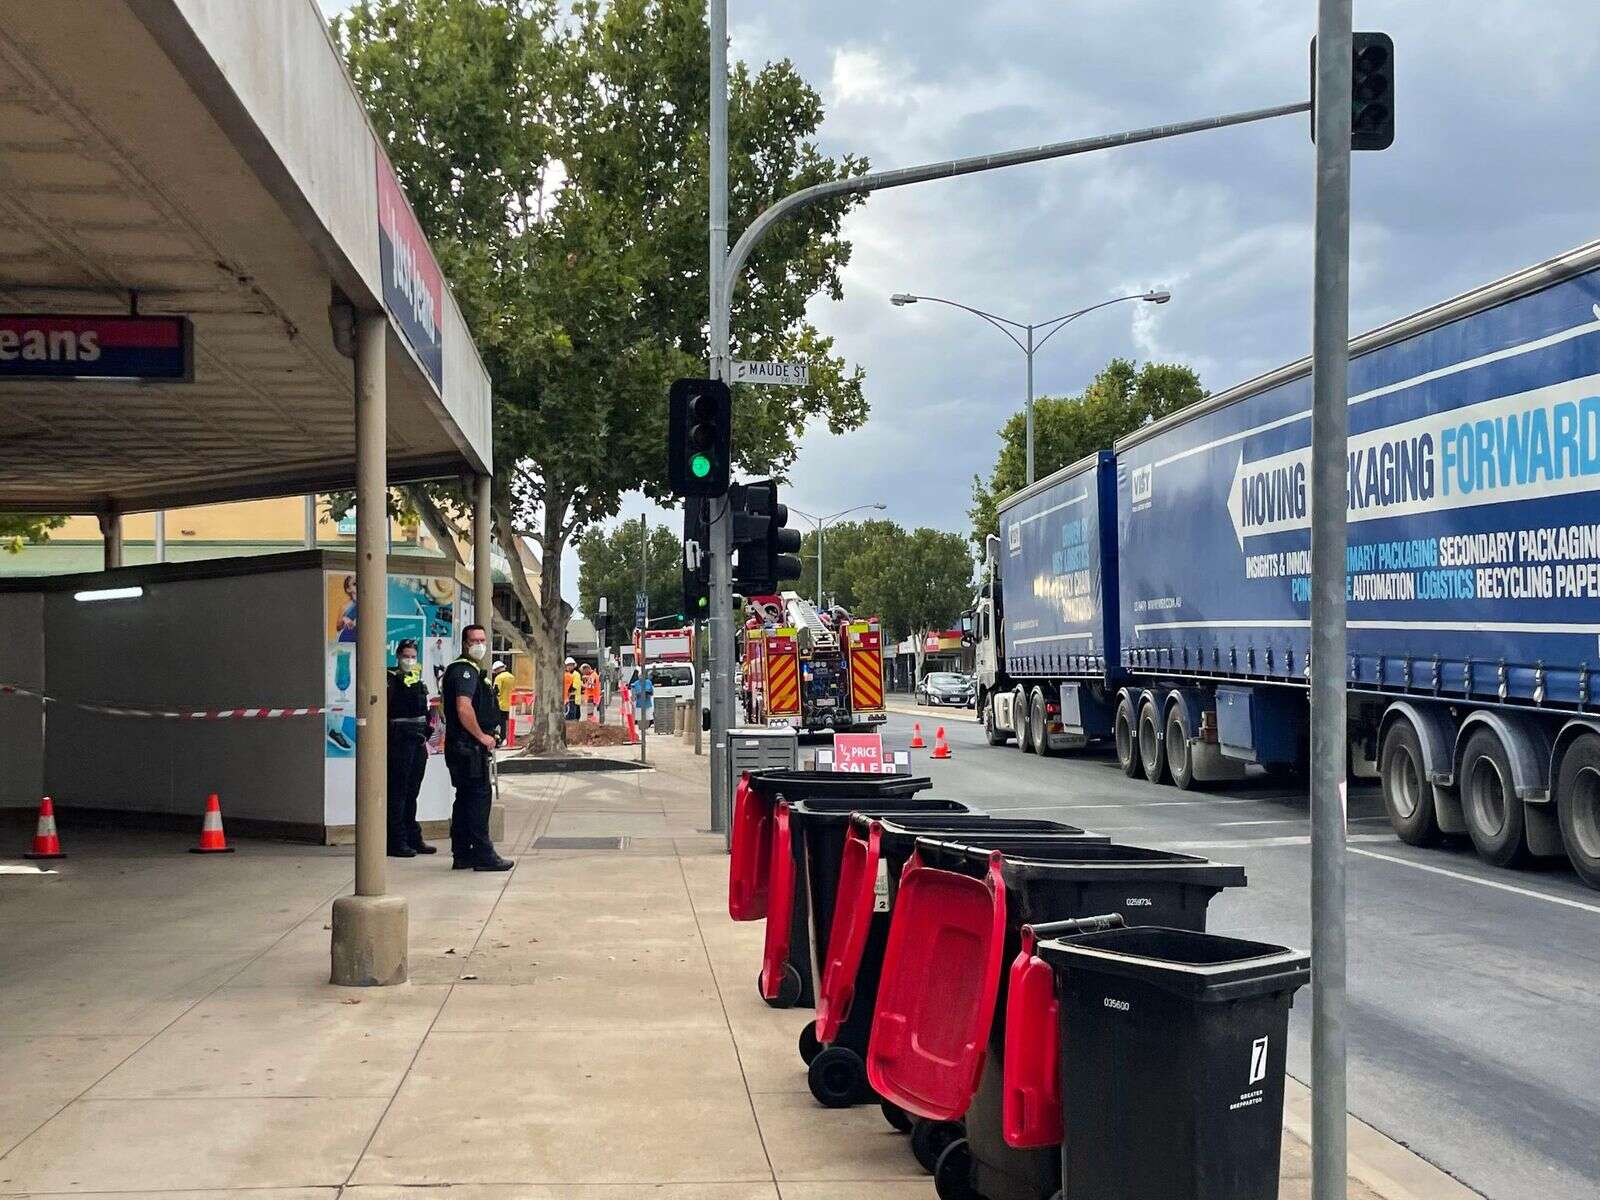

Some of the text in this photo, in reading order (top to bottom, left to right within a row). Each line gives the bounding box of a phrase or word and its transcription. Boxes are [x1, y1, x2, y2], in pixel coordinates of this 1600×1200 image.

[0, 329, 100, 361] eans
[749, 363, 806, 378] MAUDE ST
[1242, 397, 1600, 527] MOVING KAGING FORWARD
[1246, 553, 1278, 579] INSIGHTS
[1279, 552, 1286, 577] &
[1286, 549, 1312, 576] INNOV
[1346, 544, 1376, 571] IMARY
[1378, 538, 1438, 570] PACKAGING
[1439, 531, 1516, 567] SECONDARY
[1292, 577, 1312, 602] POIN
[1353, 572, 1415, 601] AUTOMATION
[1416, 569, 1475, 600] LOGISTICS
[1476, 565, 1553, 599] RECYCLING
[851, 746, 877, 758] PRICE
[839, 762, 880, 773] SALE
[879, 901, 886, 909] 2
